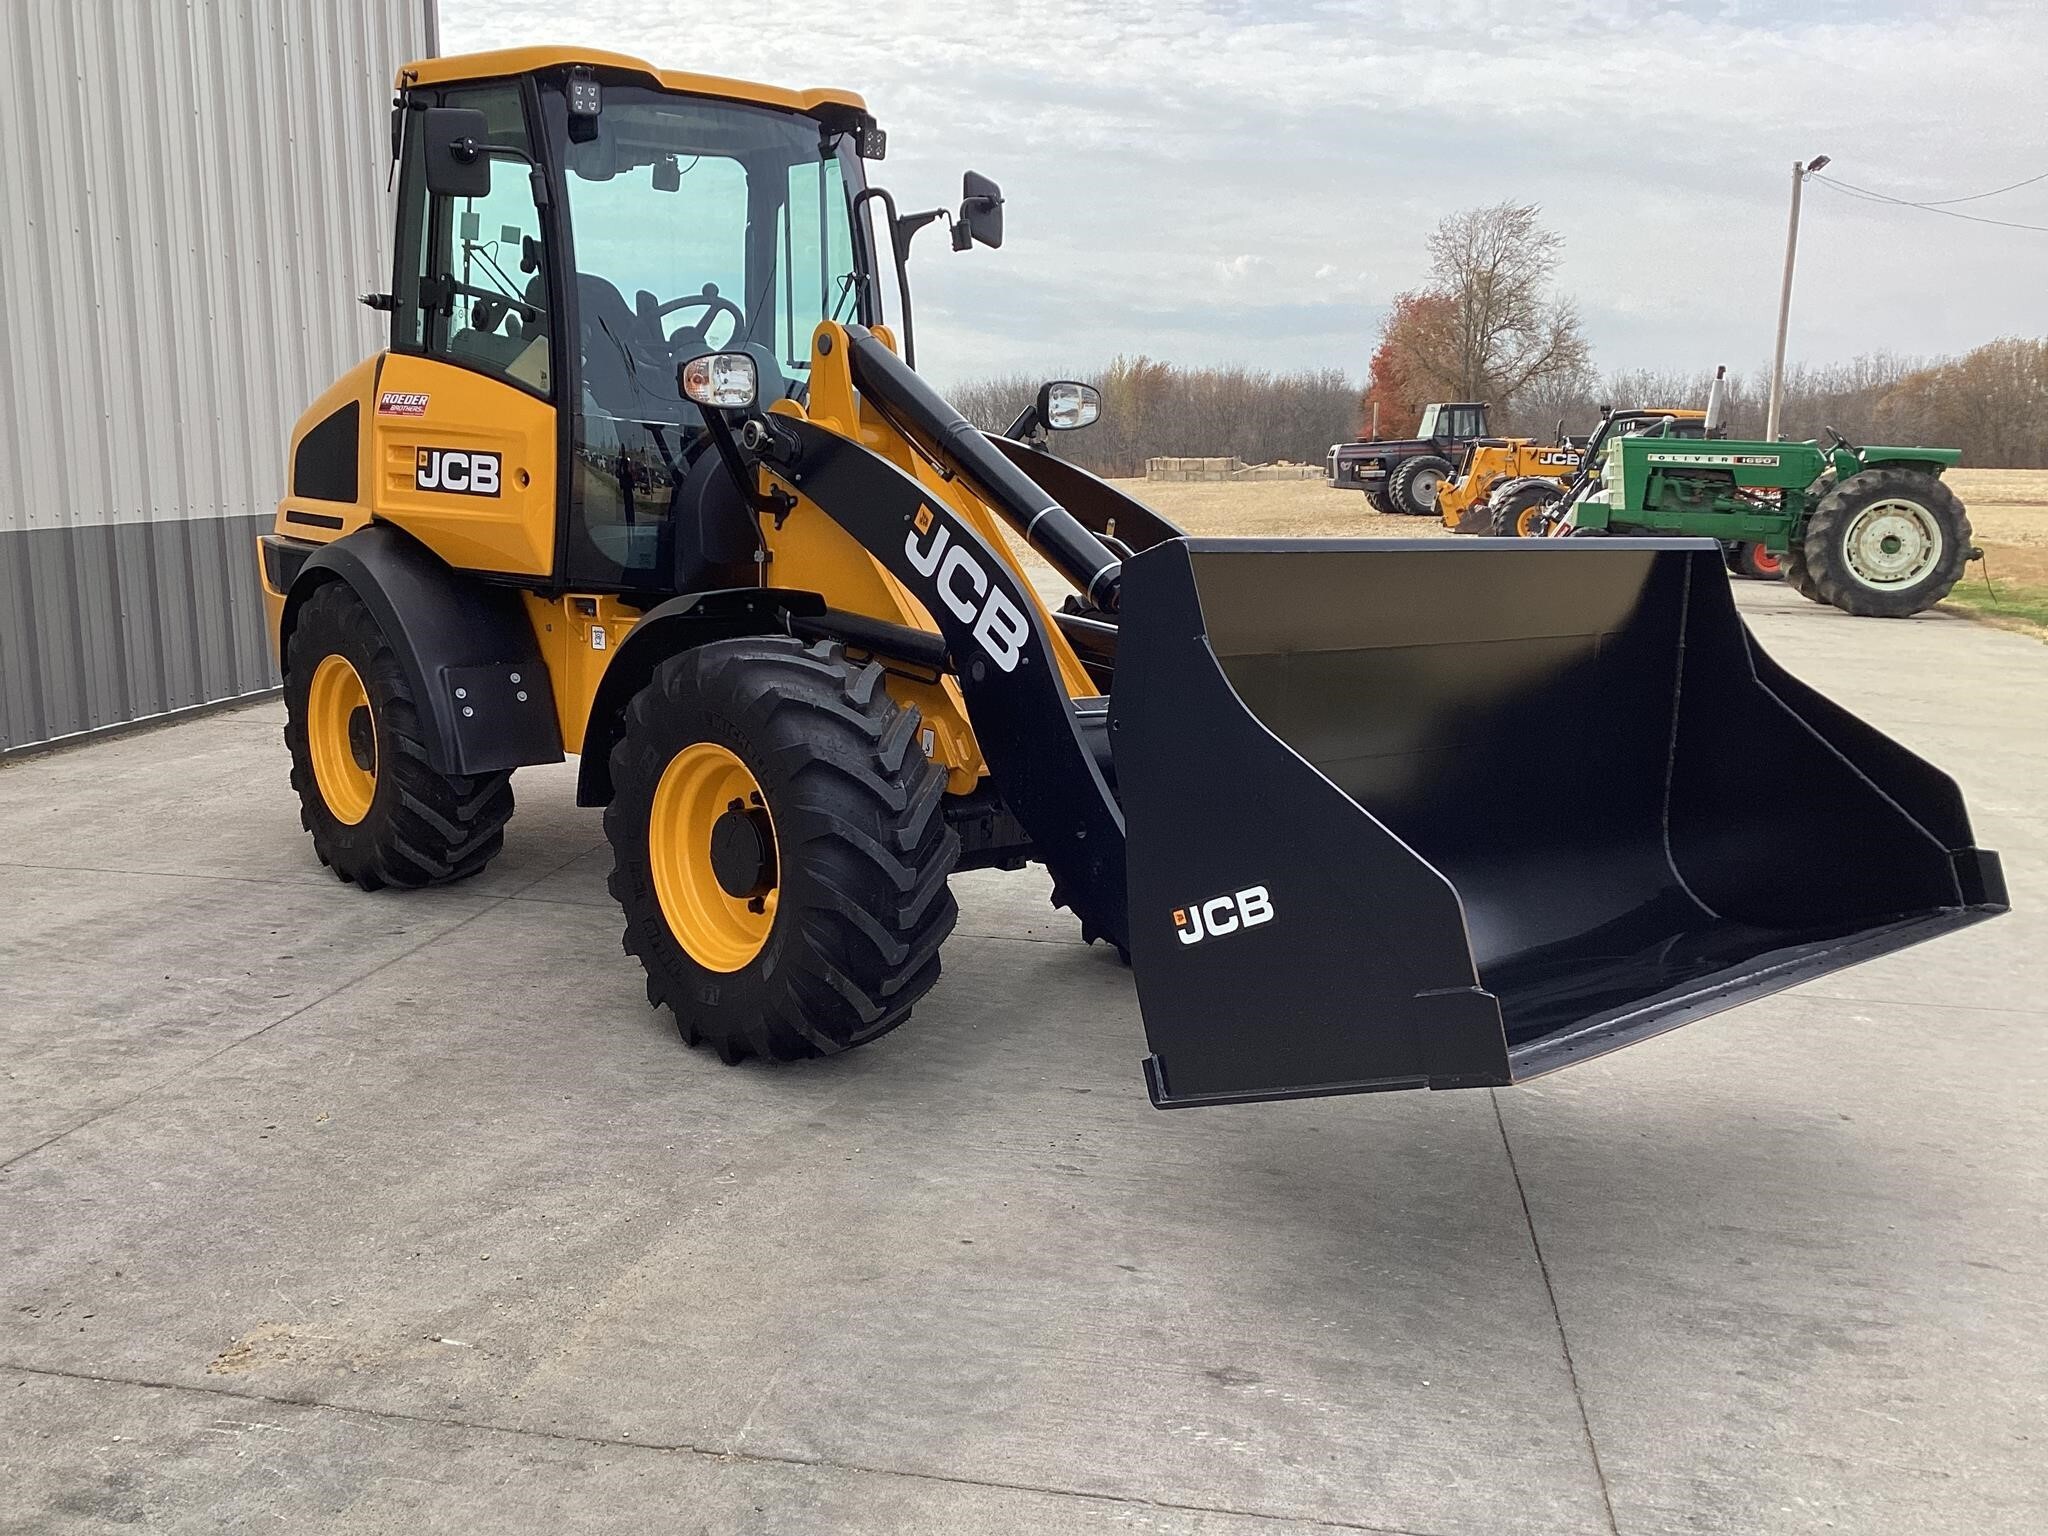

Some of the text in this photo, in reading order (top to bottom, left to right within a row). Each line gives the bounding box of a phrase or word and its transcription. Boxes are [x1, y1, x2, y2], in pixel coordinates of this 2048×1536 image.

[382, 393, 429, 405] ROEDER
[390, 404, 422, 412] BROTHERS
[1540, 452, 1580, 465] JCB
[1658, 455, 1729, 463] OLIVER
[418, 451, 499, 493] JCB
[905, 524, 1029, 673] JCB
[1178, 885, 1274, 945] JCB
